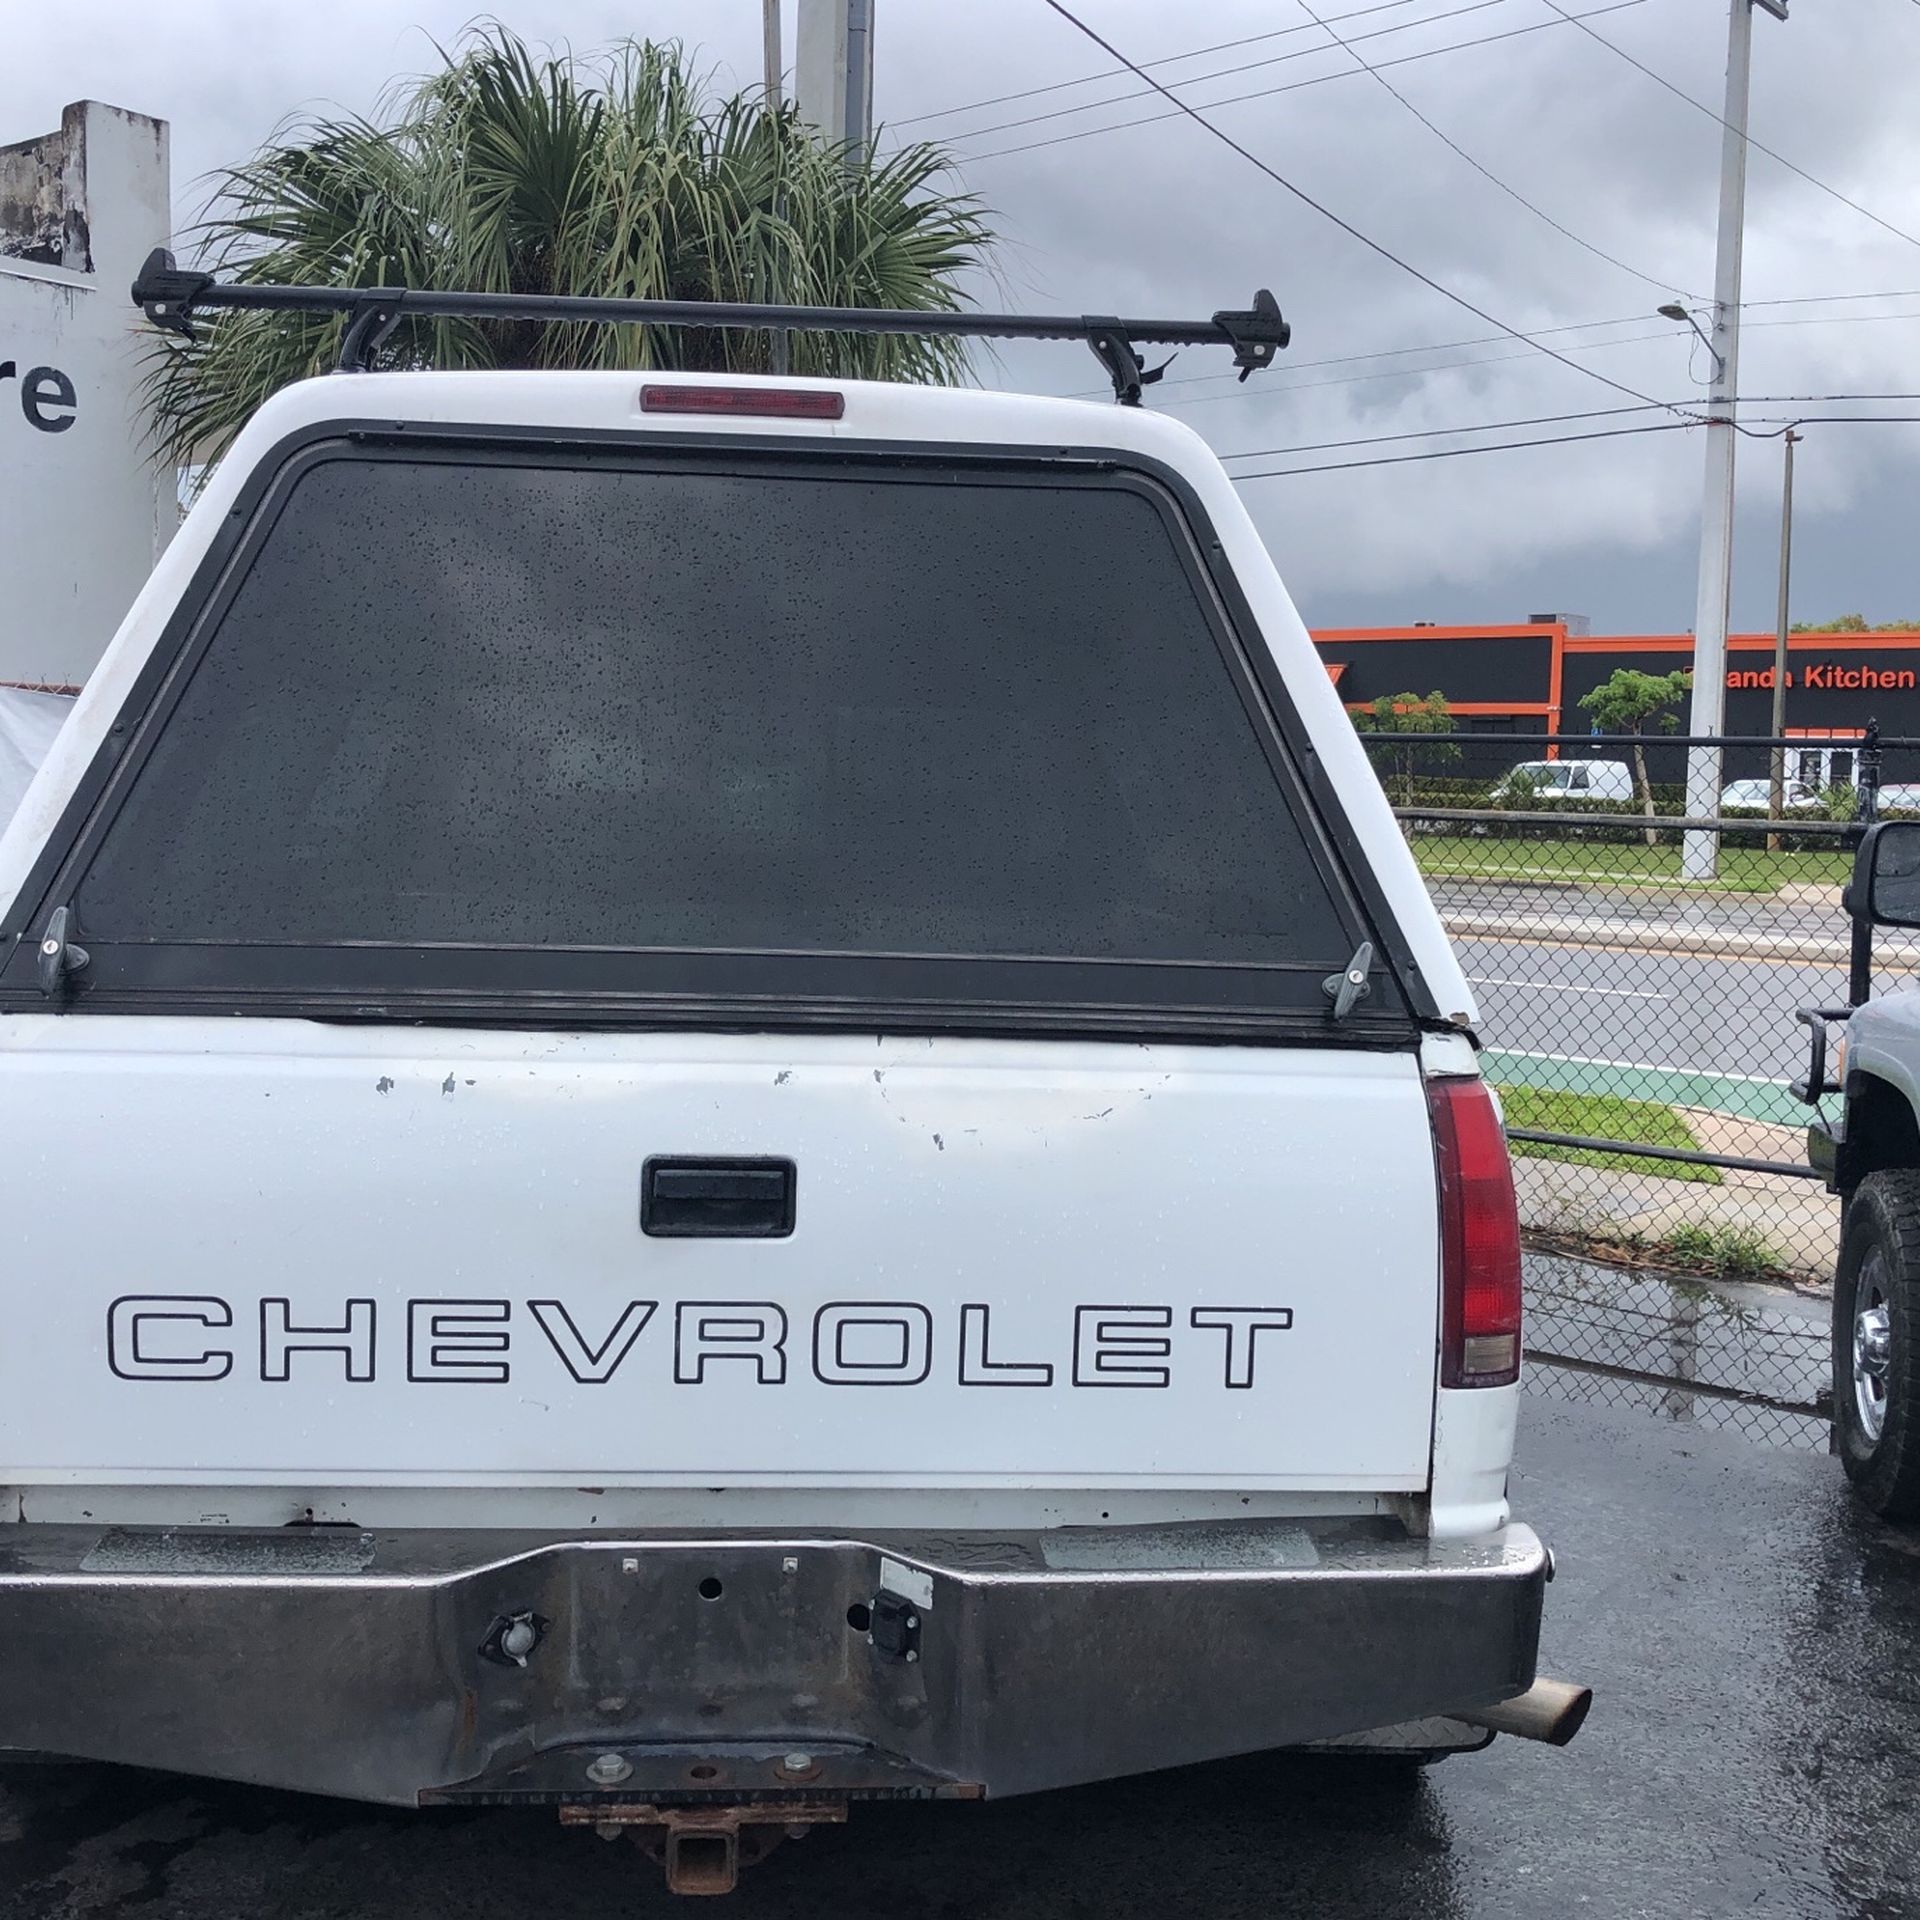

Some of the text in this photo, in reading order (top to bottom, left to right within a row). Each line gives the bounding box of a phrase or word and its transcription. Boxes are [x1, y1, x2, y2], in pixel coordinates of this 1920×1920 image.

[1726, 666, 1915, 688] and Kitchen
[108, 1295, 1294, 1389] CHEVROLET
